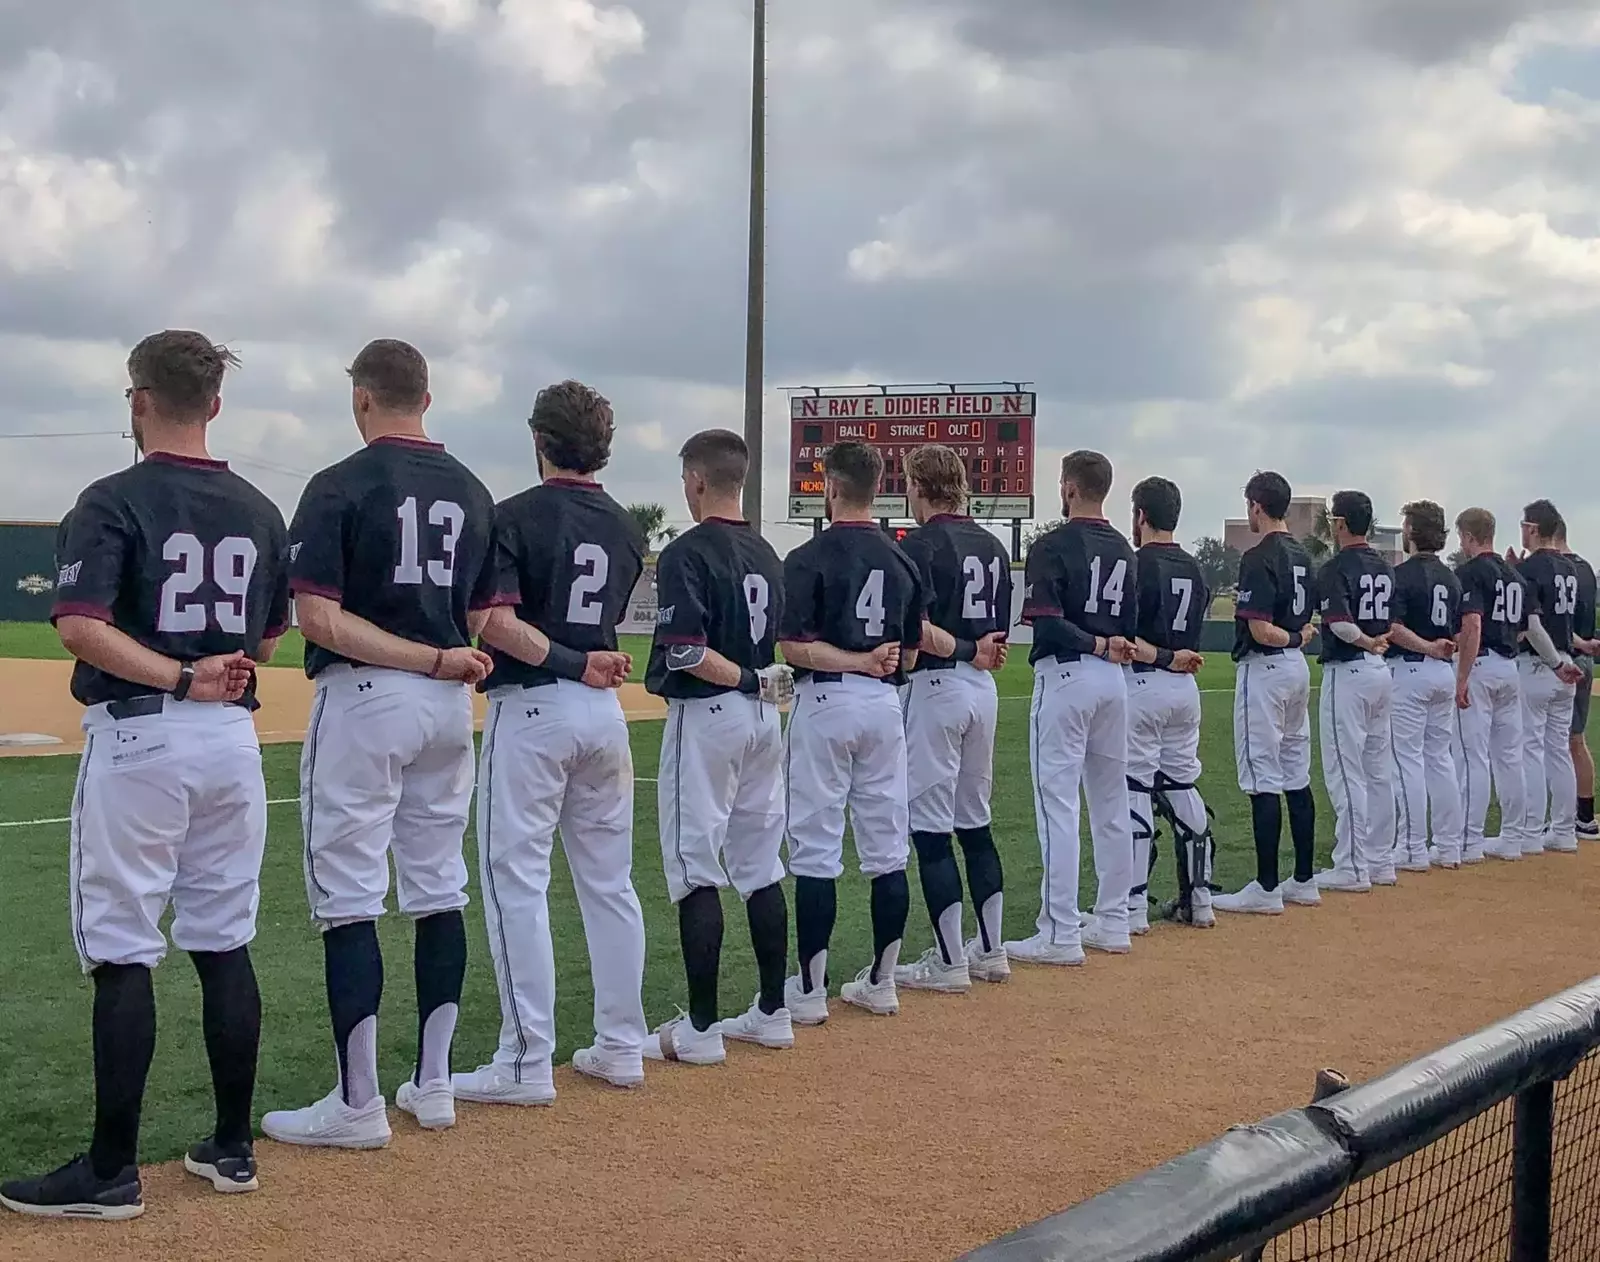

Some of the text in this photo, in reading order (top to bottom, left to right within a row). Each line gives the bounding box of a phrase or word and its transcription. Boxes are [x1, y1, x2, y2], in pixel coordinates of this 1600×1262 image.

[802, 398, 820, 416] N
[829, 396, 992, 416] RAY E. DIDIER FIELD
[1003, 396, 1022, 413] N
[840, 426, 865, 437] BALL
[887, 446, 1024, 457] 4 5 10 R H E
[890, 425, 925, 436] STRIKE
[948, 424, 969, 436] OUT
[799, 447, 811, 459] AT
[394, 496, 466, 586] 13
[159, 533, 257, 634] 29
[566, 543, 608, 625] 2
[856, 569, 885, 637] 4
[962, 556, 999, 618] 21
[1084, 556, 1127, 616] 14
[1171, 578, 1192, 632] 7
[1293, 566, 1306, 615] 5
[1358, 574, 1392, 620] 22
[1431, 585, 1448, 626] 6
[1491, 579, 1522, 623] 20
[1554, 575, 1577, 614] 33
[743, 574, 768, 645] 8
